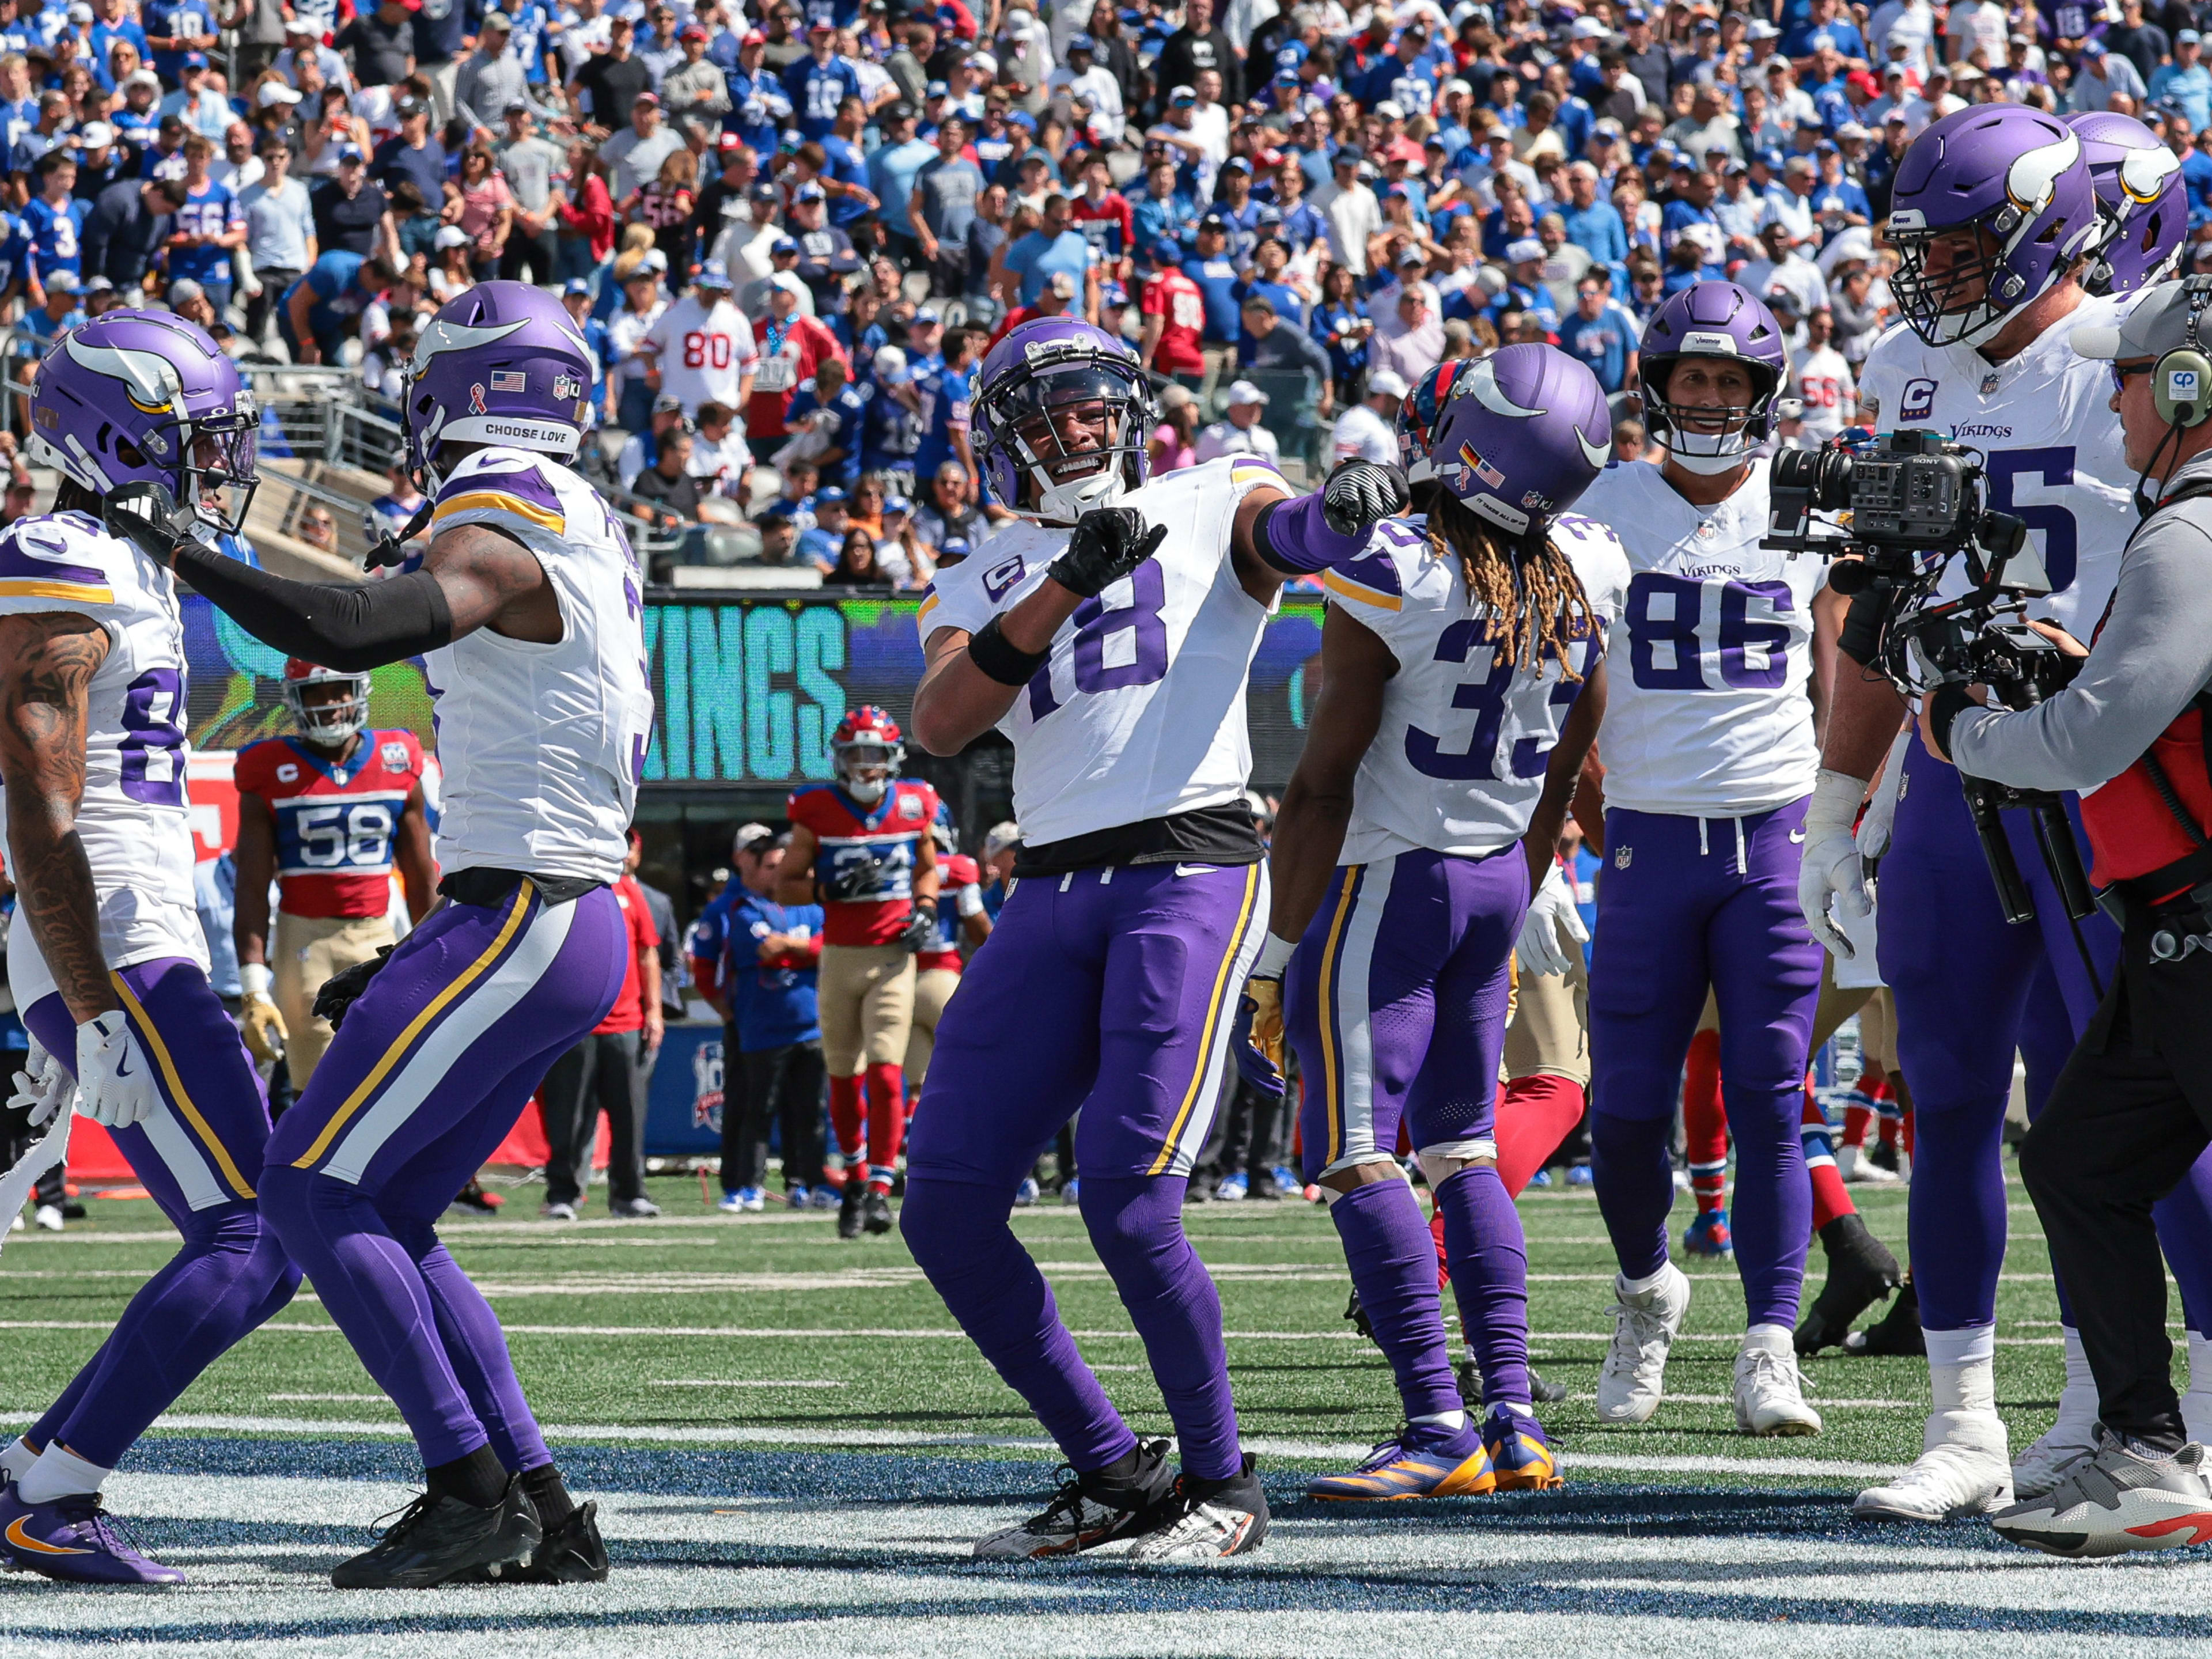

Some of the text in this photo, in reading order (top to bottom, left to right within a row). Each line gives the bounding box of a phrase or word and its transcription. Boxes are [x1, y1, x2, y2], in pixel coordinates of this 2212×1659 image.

[53, 215, 77, 258] 3
[684, 332, 730, 369] 80
[1903, 380, 1934, 410] C
[486, 424, 567, 443] CHOOSE LOVE
[1950, 418, 2013, 441] VIKINGS
[1483, 502, 1500, 515] TAKES
[1499, 513, 1510, 522] ALL
[1539, 499, 1553, 510] KJ
[1680, 562, 1741, 577] VIKINGS
[1624, 572, 1795, 690] 86
[276, 763, 299, 783] C
[297, 805, 393, 867] 58
